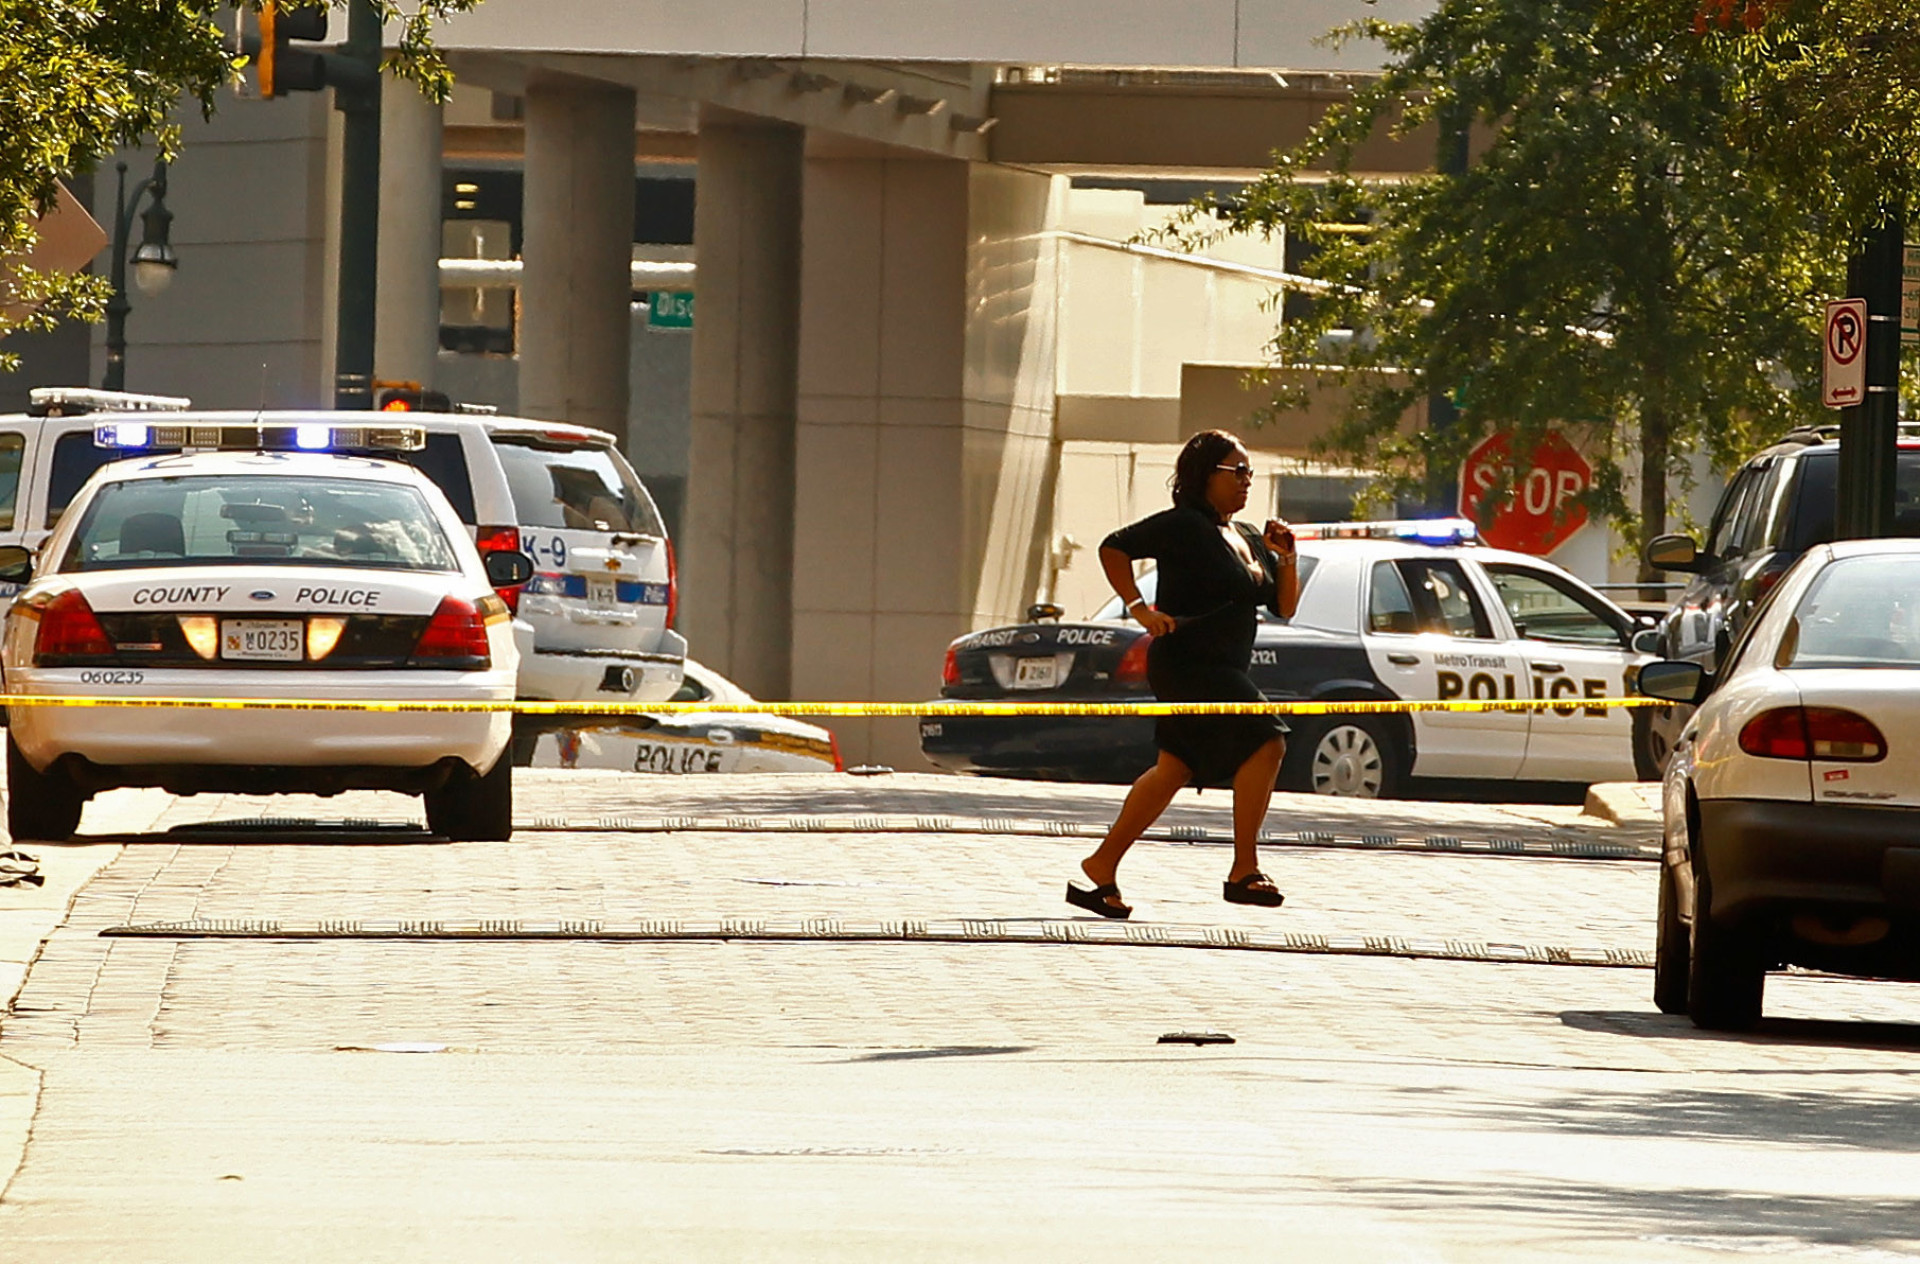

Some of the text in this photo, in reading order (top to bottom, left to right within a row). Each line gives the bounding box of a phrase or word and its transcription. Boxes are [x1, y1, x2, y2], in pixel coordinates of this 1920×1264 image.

[522, 535, 566, 568] K-9
[133, 586, 231, 605] COUNTY
[296, 587, 381, 607] POLICE
[257, 630, 299, 652] 0235
[966, 628, 1116, 648] TRANSIT POLICE
[1251, 649, 1278, 665] 2121
[80, 670, 144, 685] 060235
[1435, 670, 1609, 719] POLICE
[634, 744, 724, 773] POLICE
